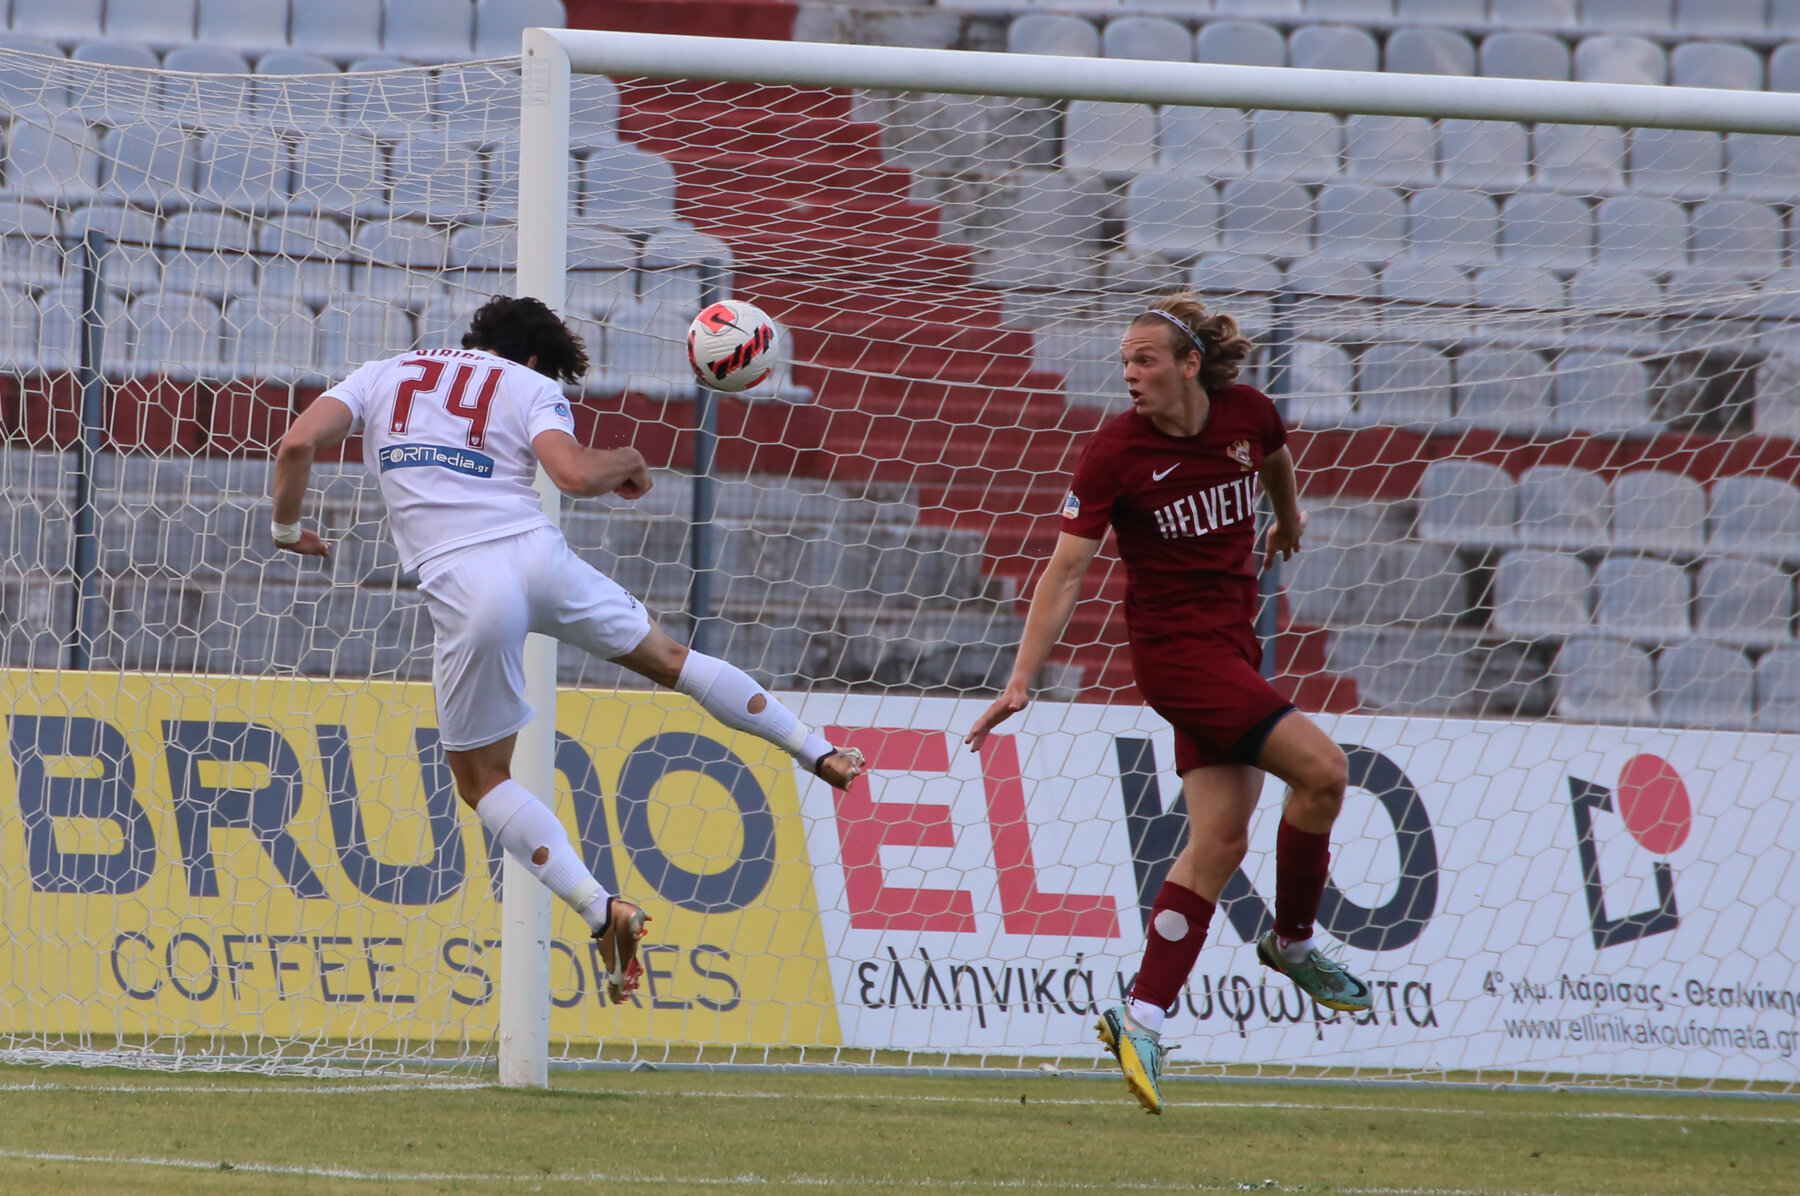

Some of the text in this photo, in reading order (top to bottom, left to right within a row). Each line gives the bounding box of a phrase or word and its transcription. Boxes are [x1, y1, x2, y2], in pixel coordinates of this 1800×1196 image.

[388, 359, 505, 450] 74
[1154, 471, 1260, 539] HELVETI
[111, 930, 417, 1004] COFFEE
[858, 946, 1099, 1028] ελληνικά
[1504, 1014, 1799, 1058] www.ellinikakoufomata.gr
